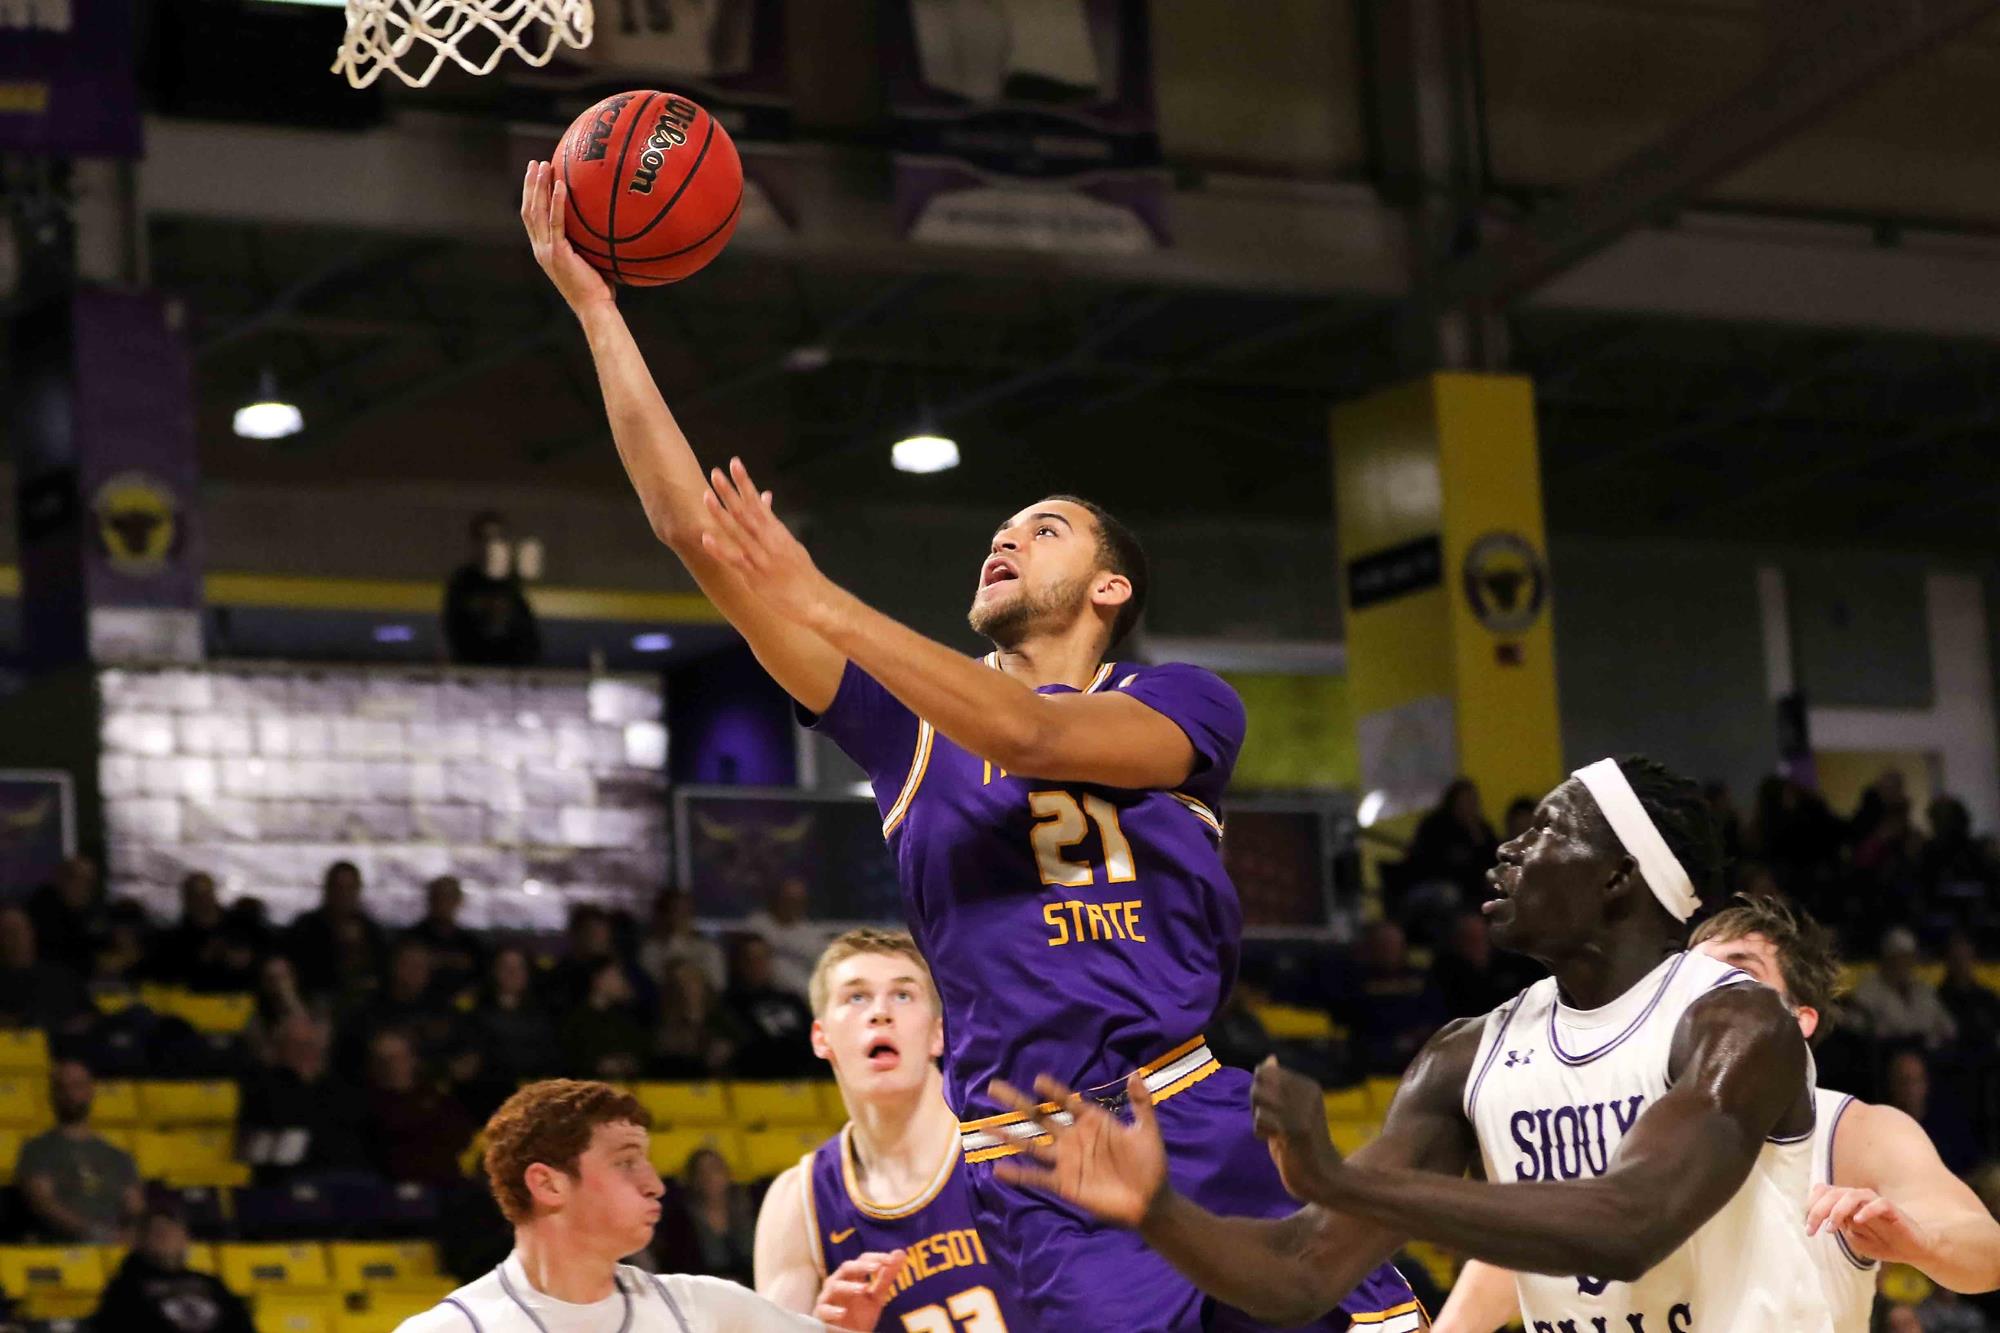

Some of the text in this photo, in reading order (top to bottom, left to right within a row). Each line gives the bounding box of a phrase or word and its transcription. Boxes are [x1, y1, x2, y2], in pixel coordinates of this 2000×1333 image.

[629, 98, 697, 195] Wilson
[1028, 790, 1137, 887] 21
[1043, 900, 1146, 947] STATE
